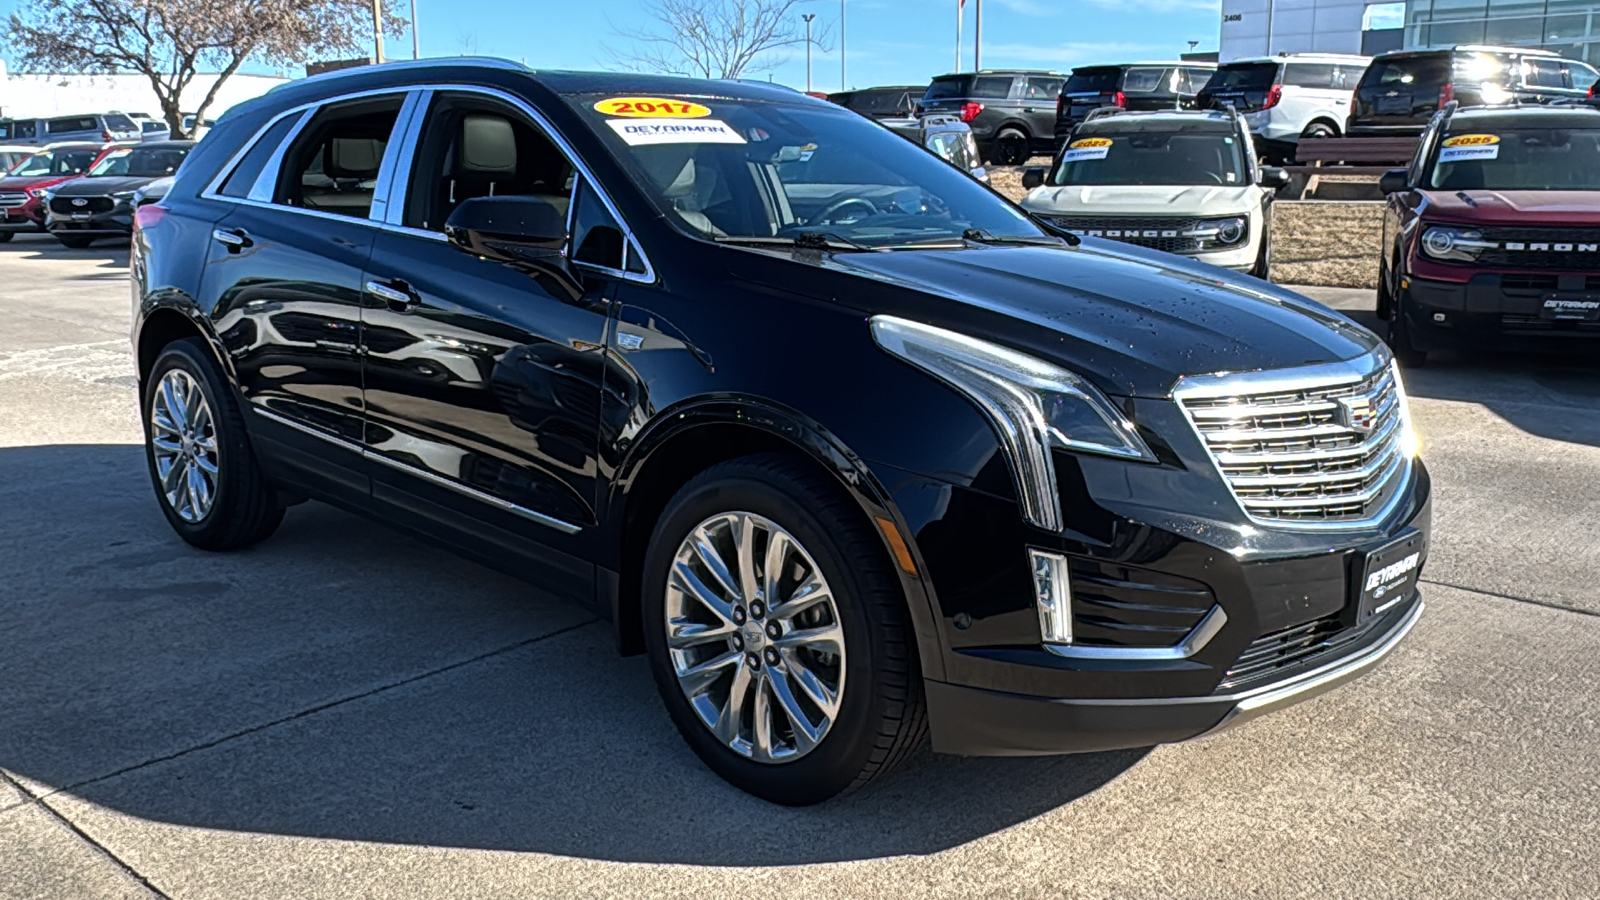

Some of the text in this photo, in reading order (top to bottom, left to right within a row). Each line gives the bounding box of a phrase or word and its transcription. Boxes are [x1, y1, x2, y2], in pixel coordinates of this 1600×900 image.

[1224, 14, 1242, 22] 2406
[612, 102, 693, 114] 2017
[624, 125, 725, 134] DEYARMAN
[1543, 300, 1600, 309] DEYARMAN
[1365, 551, 1420, 592] DEYARMAN
